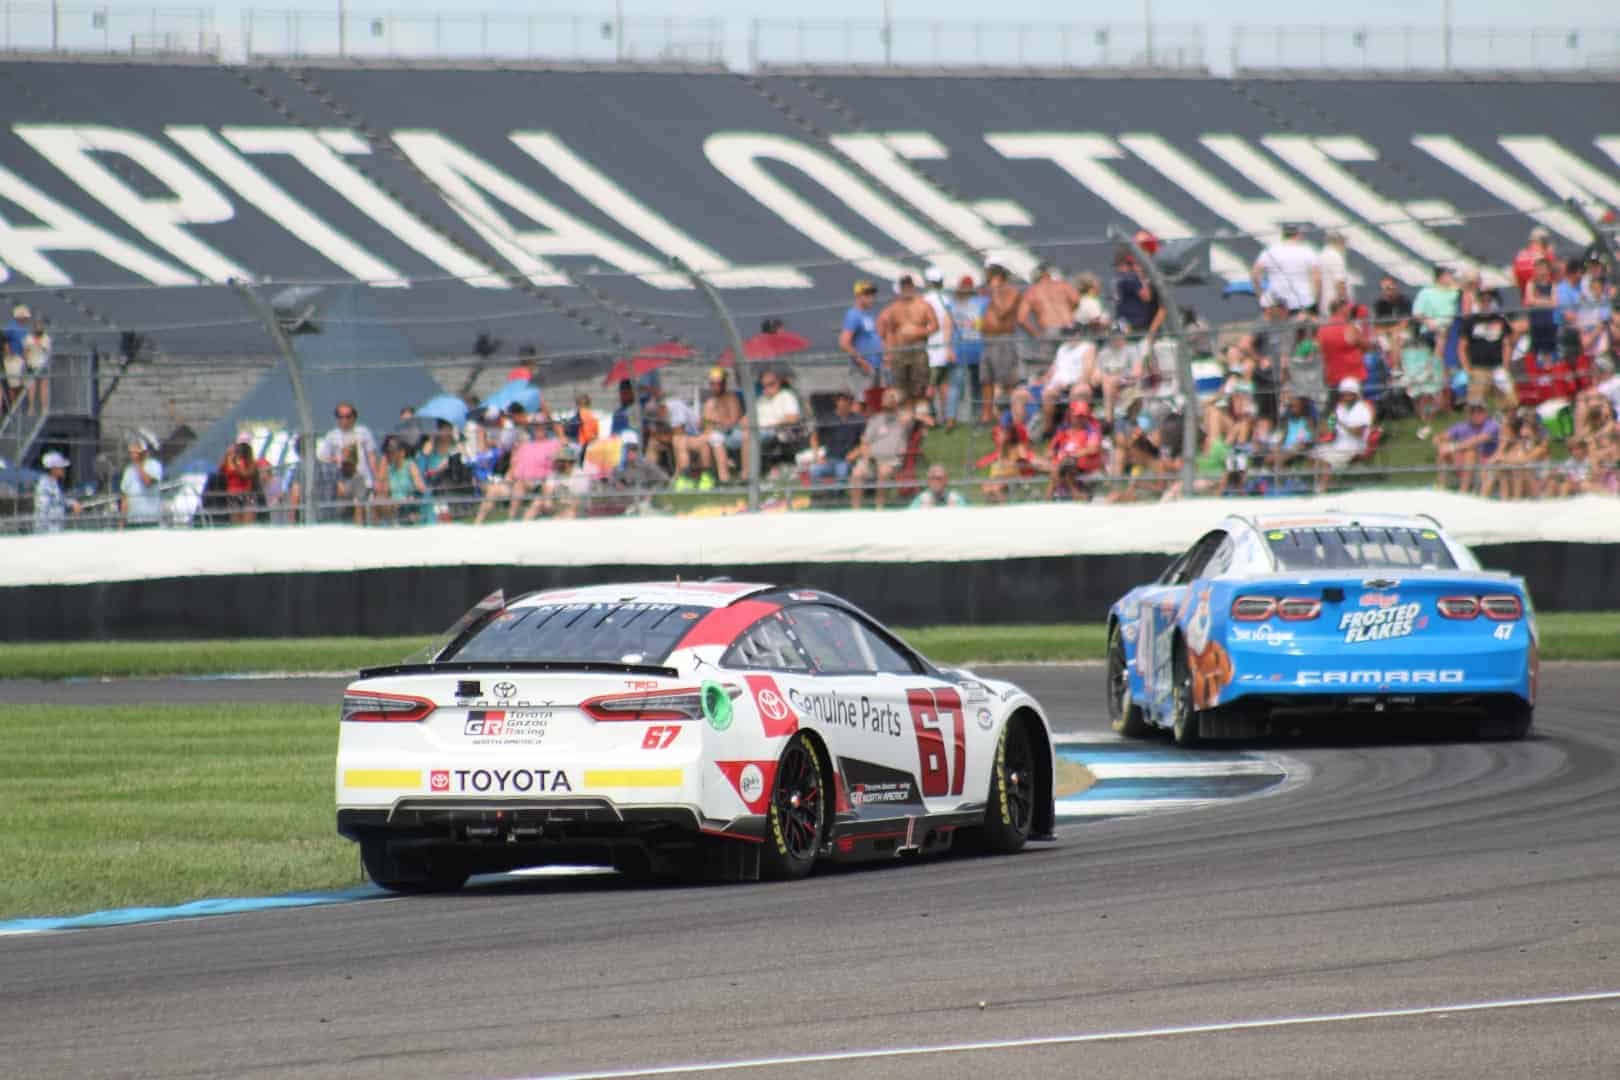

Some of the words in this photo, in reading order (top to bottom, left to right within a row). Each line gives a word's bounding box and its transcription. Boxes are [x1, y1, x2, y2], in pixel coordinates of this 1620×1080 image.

[0, 126, 814, 289] APITAL
[703, 133, 1036, 289] OF
[984, 133, 1514, 289] THE
[1339, 602, 1420, 630] FROSTED
[1344, 620, 1412, 643] FLAKES
[1494, 623, 1513, 640] 47
[1297, 670, 1464, 684] CAMARO
[509, 711, 553, 719] TOYOTA
[861, 696, 901, 736] Parts
[642, 726, 682, 749] 67
[906, 687, 966, 797] 67
[455, 769, 572, 792] TOYOTA
